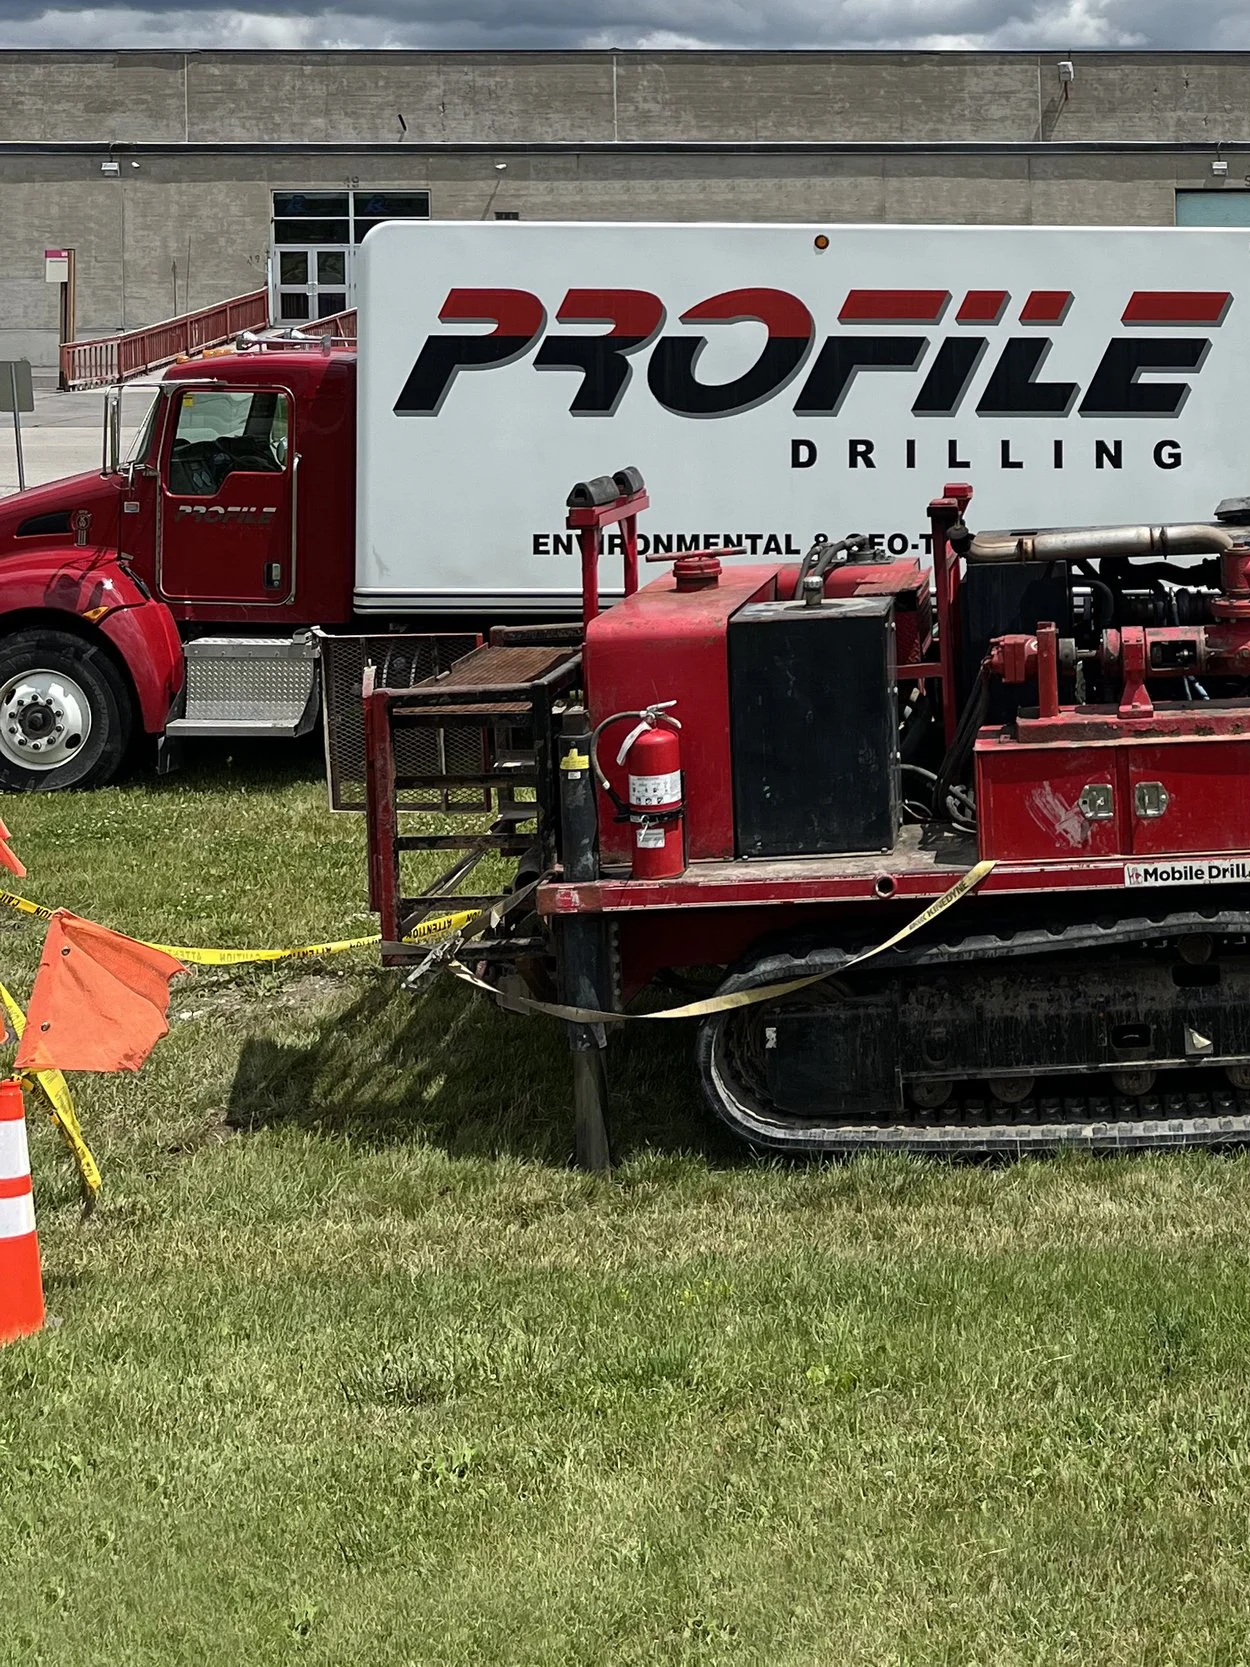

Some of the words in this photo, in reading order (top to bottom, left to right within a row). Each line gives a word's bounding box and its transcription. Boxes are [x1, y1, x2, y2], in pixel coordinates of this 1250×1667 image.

[392, 287, 1234, 419] PROFILE
[790, 438, 1182, 469] DRILLING
[174, 505, 277, 524] PROFILE
[1143, 866, 1205, 882] Mobile
[926, 880, 969, 917] KINEDYNE
